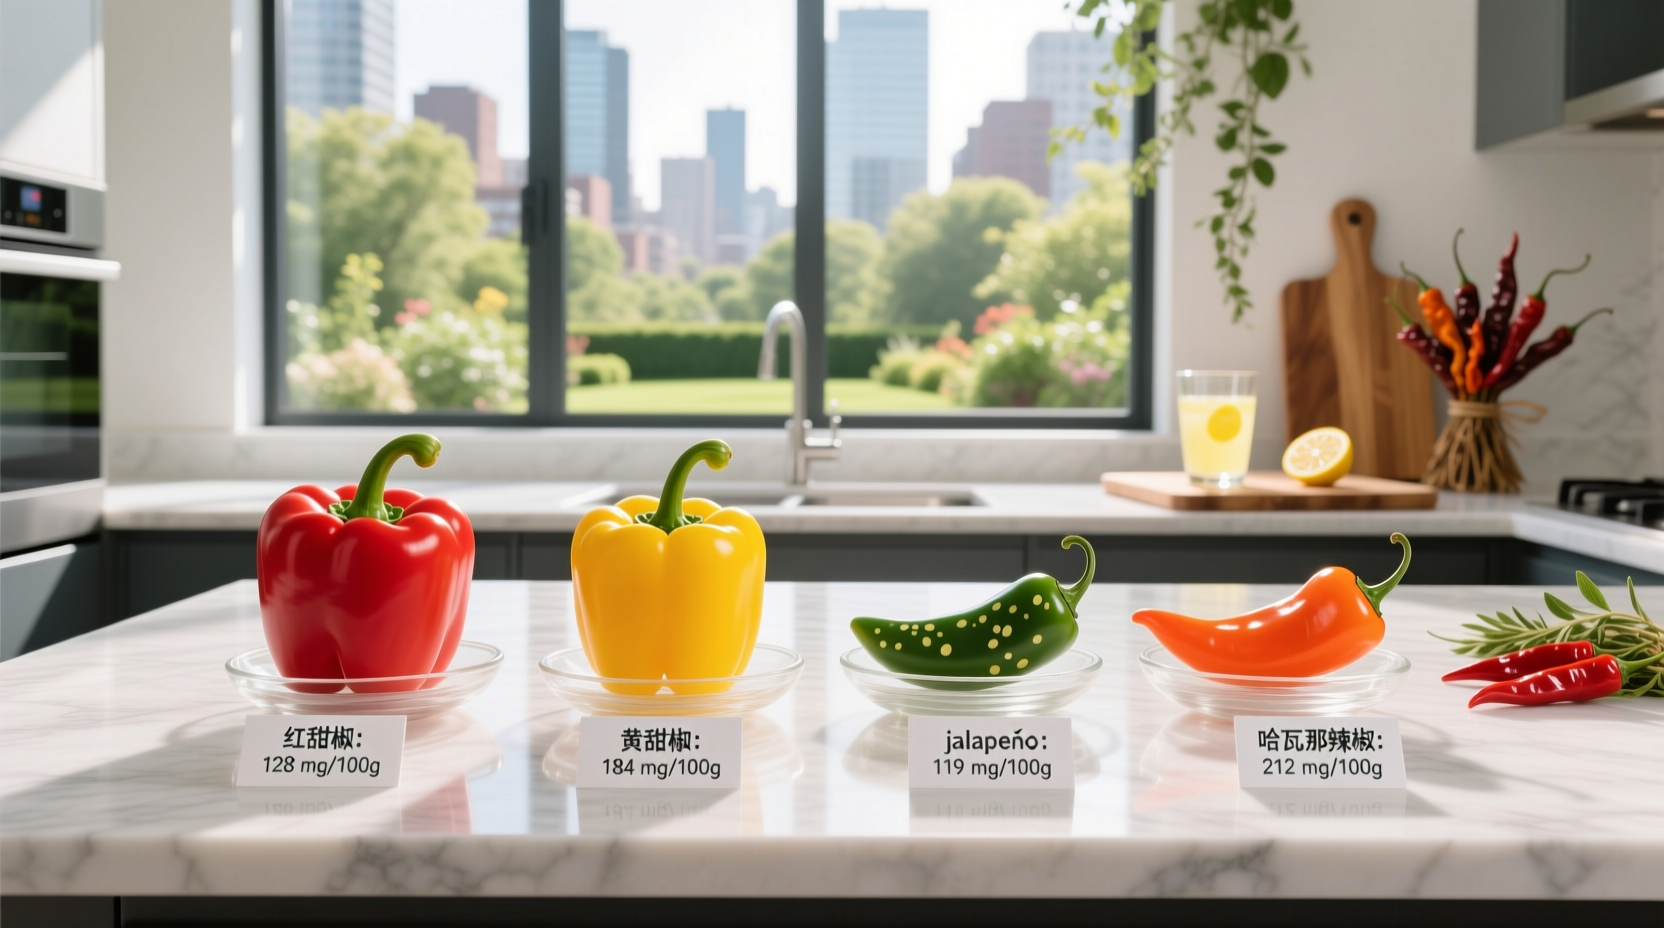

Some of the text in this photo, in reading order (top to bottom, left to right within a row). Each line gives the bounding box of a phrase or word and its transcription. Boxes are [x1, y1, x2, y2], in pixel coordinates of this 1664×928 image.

[263, 755, 381, 778] 128 mg/100g
[603, 758, 721, 780] 184 mg/100g
[933, 758, 1052, 780] 119 mg/100g
[1262, 758, 1383, 780] 212 mg/100g
